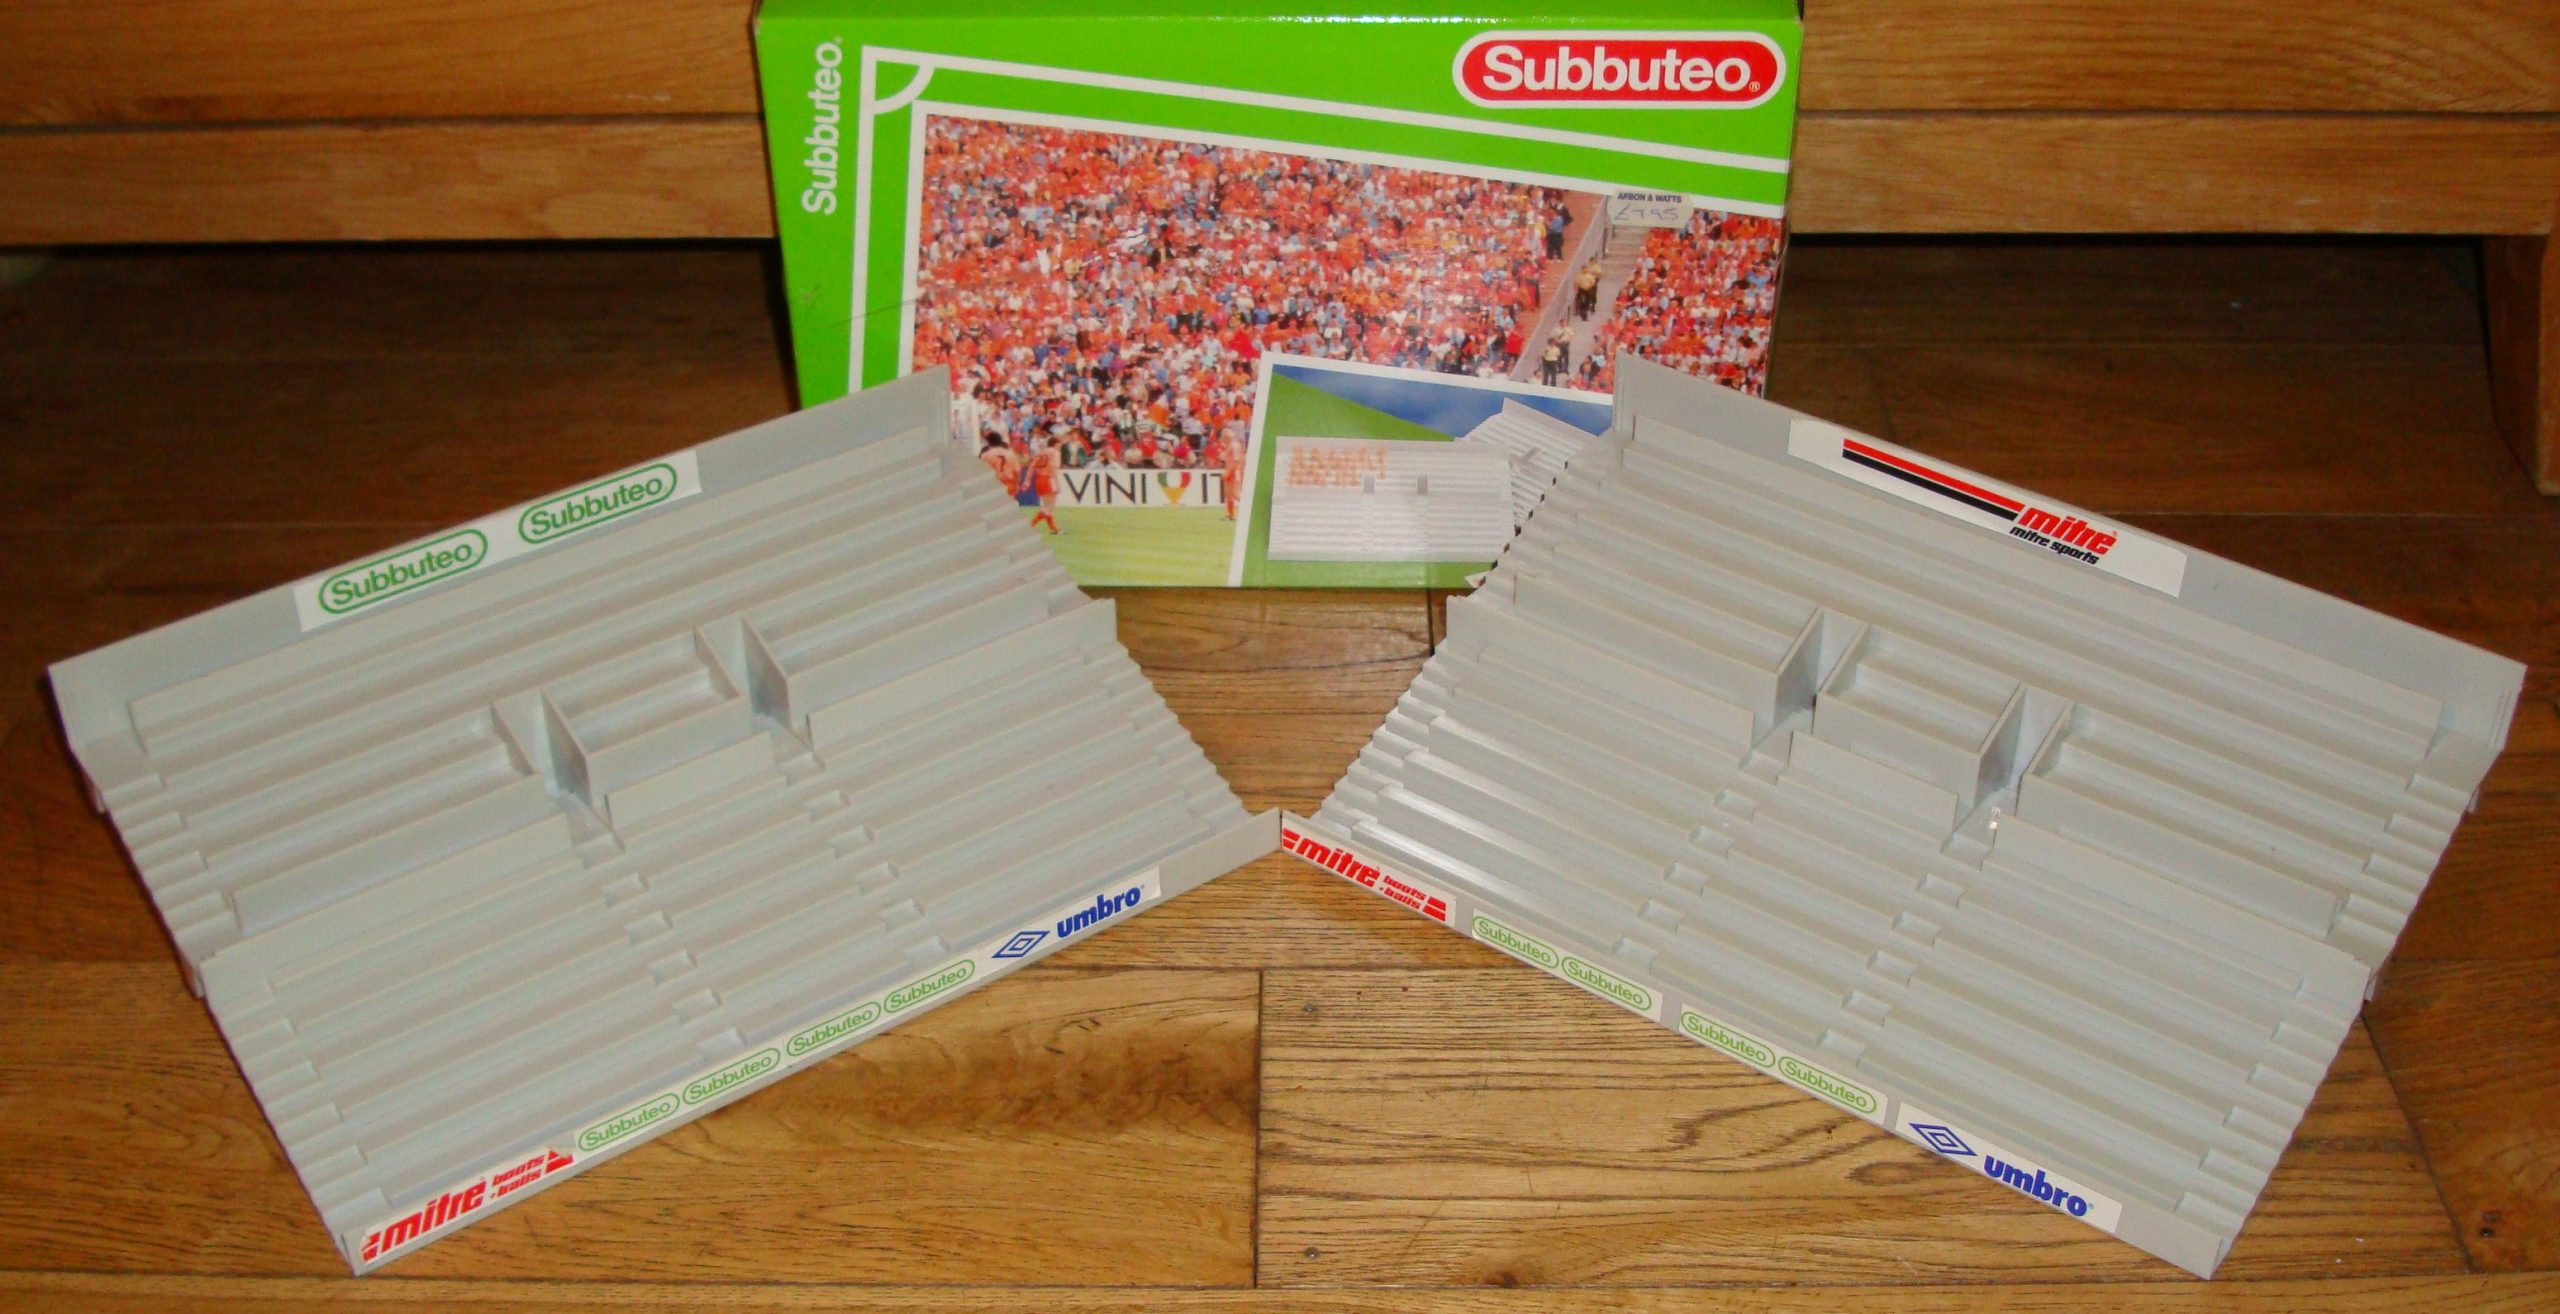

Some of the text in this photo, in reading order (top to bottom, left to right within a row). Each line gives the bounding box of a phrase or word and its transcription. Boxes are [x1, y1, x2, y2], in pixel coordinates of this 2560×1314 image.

[802, 41, 843, 216] Subbuteo
[1655, 195, 1682, 203] WATTS
[1063, 472, 1147, 504] VINI
[331, 476, 663, 605] Subbuteo Subbuteo
[2008, 526, 2100, 565] mitre sports
[2017, 507, 2117, 556] mitre
[1296, 838, 1427, 901] mitre boots
[1056, 887, 1141, 939] umbro
[1478, 920, 1643, 1005] Subbuteo Subbuteo
[890, 967, 967, 1009] Subbuteo
[793, 1009, 873, 1051] Subbuteo
[689, 1056, 772, 1100] Subbuteo
[1688, 1015, 1867, 1108] Subbuteo Subbuteo
[585, 1101, 671, 1147] Subbuteo
[1984, 1155, 2088, 1217] umbro
[381, 1181, 487, 1253] mitre
